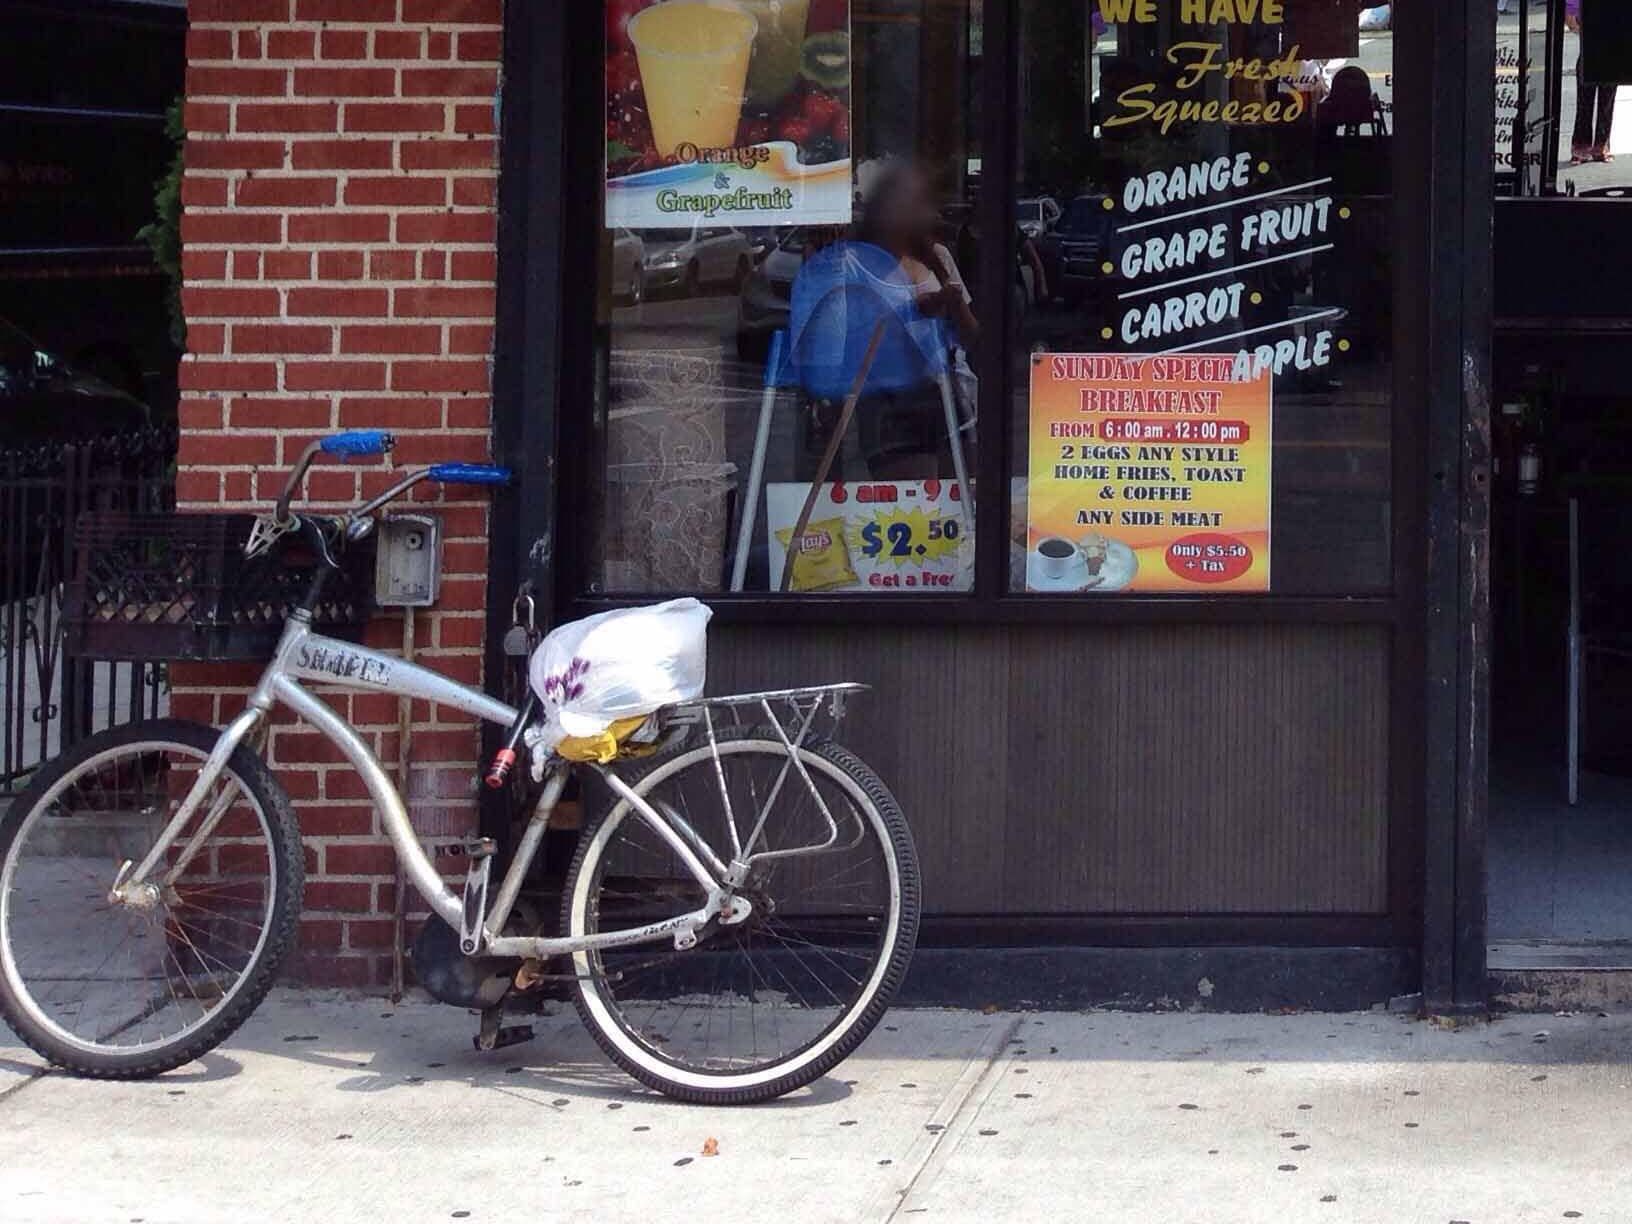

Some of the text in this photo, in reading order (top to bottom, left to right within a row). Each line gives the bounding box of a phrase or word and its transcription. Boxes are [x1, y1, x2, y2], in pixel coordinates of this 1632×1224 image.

[1167, 40, 1303, 90] Fresh
[1103, 82, 1305, 136] Squeezed
[675, 142, 770, 169] Orange
[713, 172, 730, 189] &
[1123, 152, 1251, 213] ORANGE
[656, 186, 793, 217] Grapefruit
[1121, 196, 1333, 278] GRAPE FRUIT
[1121, 282, 1246, 343] CARROT
[1051, 355, 1146, 381] SUNDAY
[1230, 330, 1332, 384] APPLE
[1080, 389, 1222, 414] BREAKFAST
[1051, 422, 1095, 438] FROM
[1144, 425, 1166, 438] am
[1220, 425, 1240, 442] pm
[1061, 445, 1239, 462] 2 EGGS ANY STYLE
[1054, 465, 1246, 482] HOME FRIES, TOAST
[830, 480, 848, 503] 6
[856, 484, 898, 503] am
[923, 478, 942, 501] 9
[1099, 486, 1192, 501] & COFFEE
[1077, 511, 1223, 527] ANY SIDE MEAT
[1172, 543, 1247, 558] Only $5.50
[1200, 560, 1225, 572] Tax
[869, 572, 900, 586] Get
[906, 574, 917, 586] a
